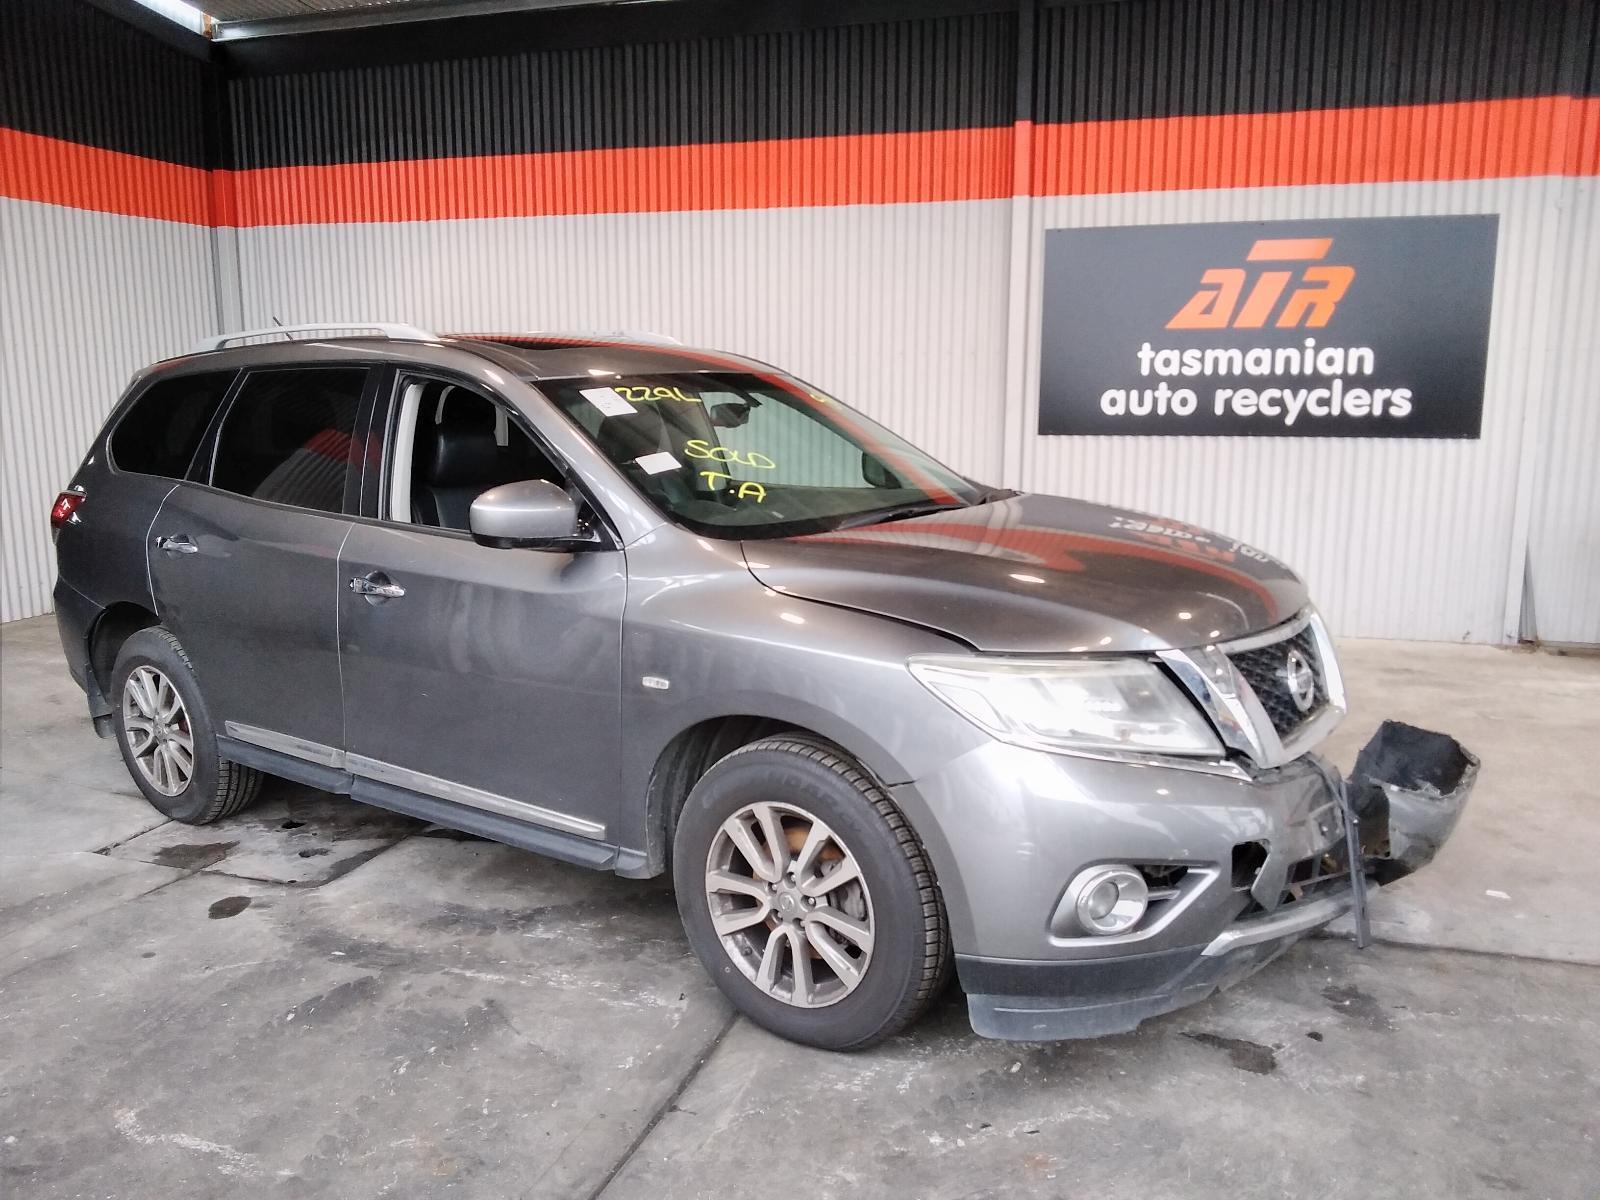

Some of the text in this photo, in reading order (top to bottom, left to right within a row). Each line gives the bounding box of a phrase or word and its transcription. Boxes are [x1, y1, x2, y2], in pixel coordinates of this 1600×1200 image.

[1136, 337, 1375, 377] tasmanian
[1099, 378, 1413, 427] auto recyclers
[684, 439, 777, 470] SOLD
